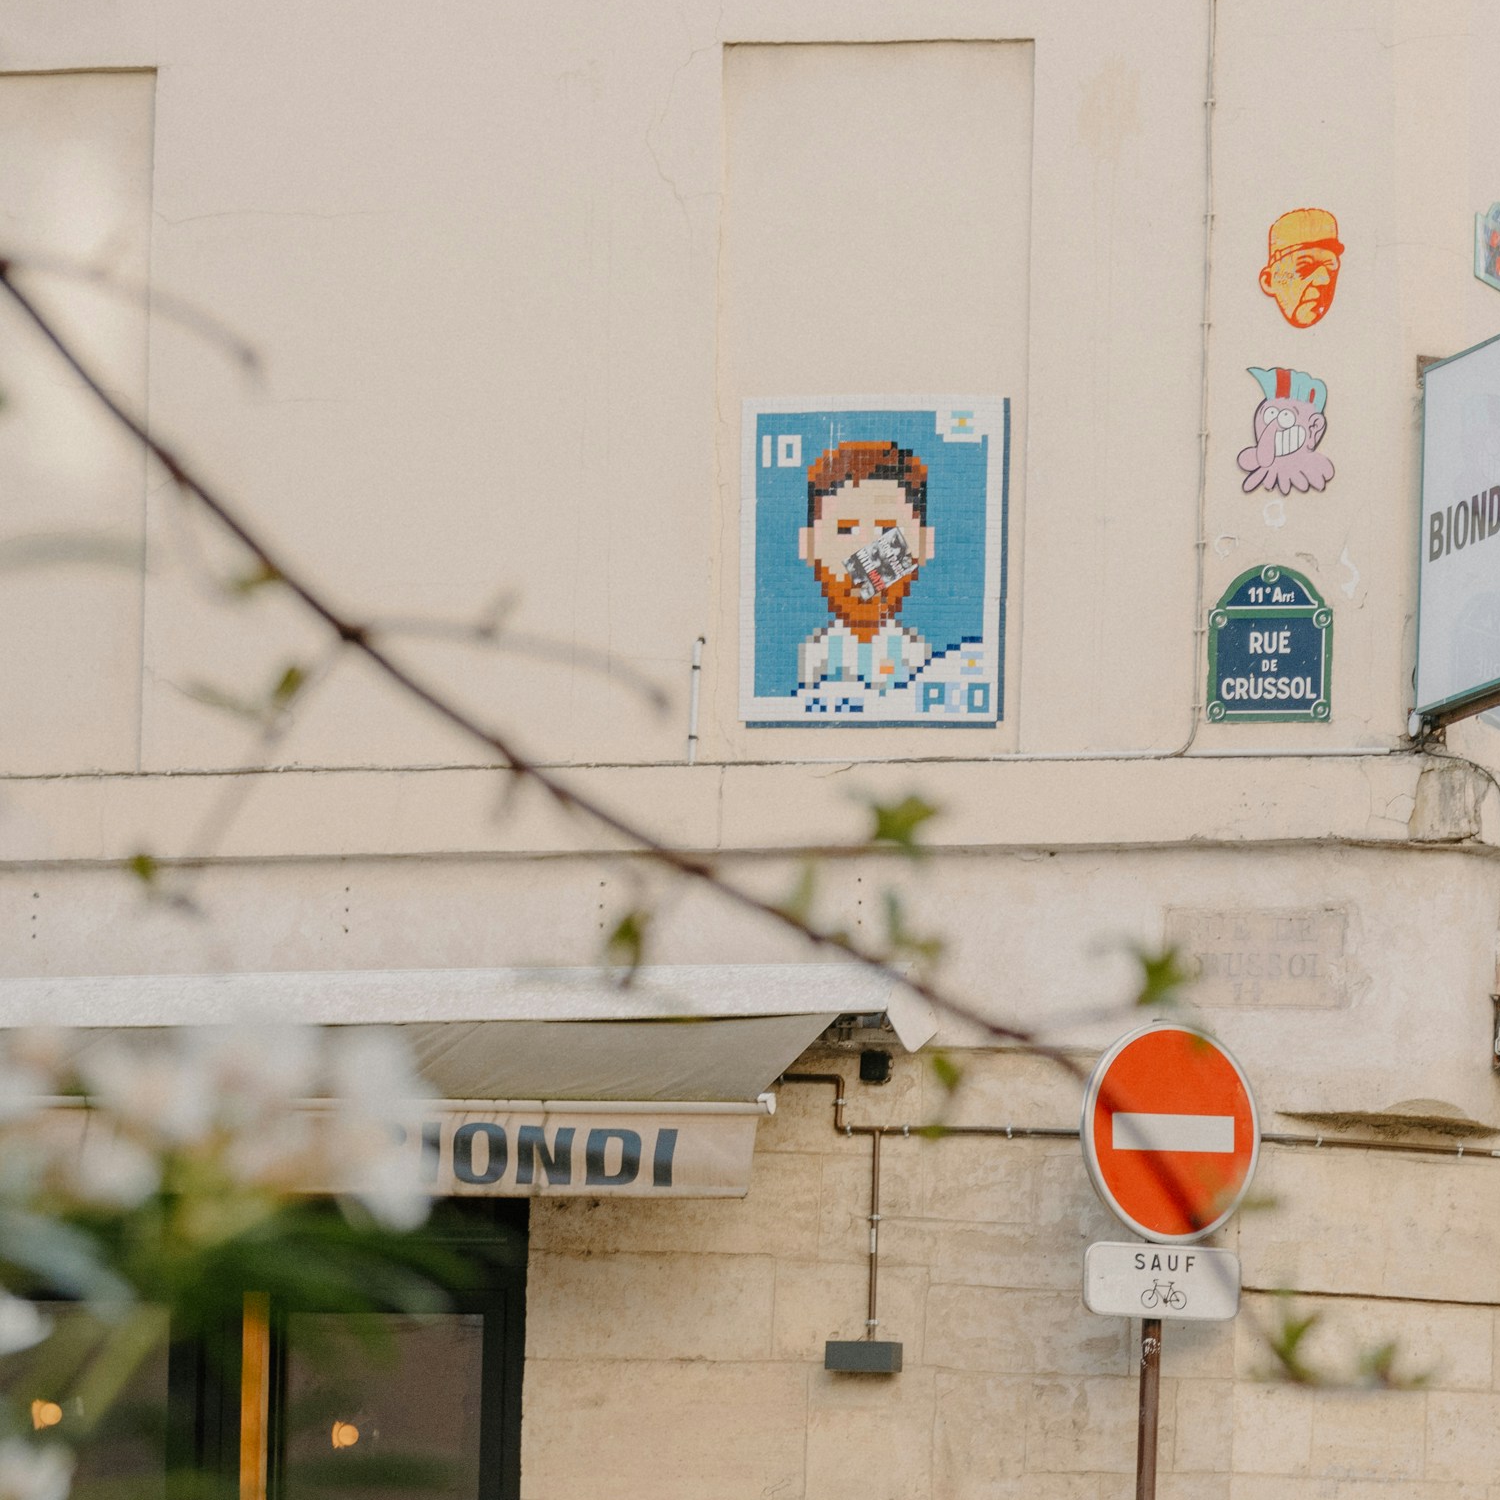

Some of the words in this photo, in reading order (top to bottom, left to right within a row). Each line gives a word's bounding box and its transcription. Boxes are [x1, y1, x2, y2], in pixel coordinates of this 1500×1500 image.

[762, 434, 802, 468] 10
[1249, 631, 1292, 655] RUE
[1261, 659, 1278, 672] DE
[1221, 676, 1318, 700] CRUSSOL
[395, 1121, 679, 1187] IONDI
[1134, 1252, 1196, 1273] SAUF
